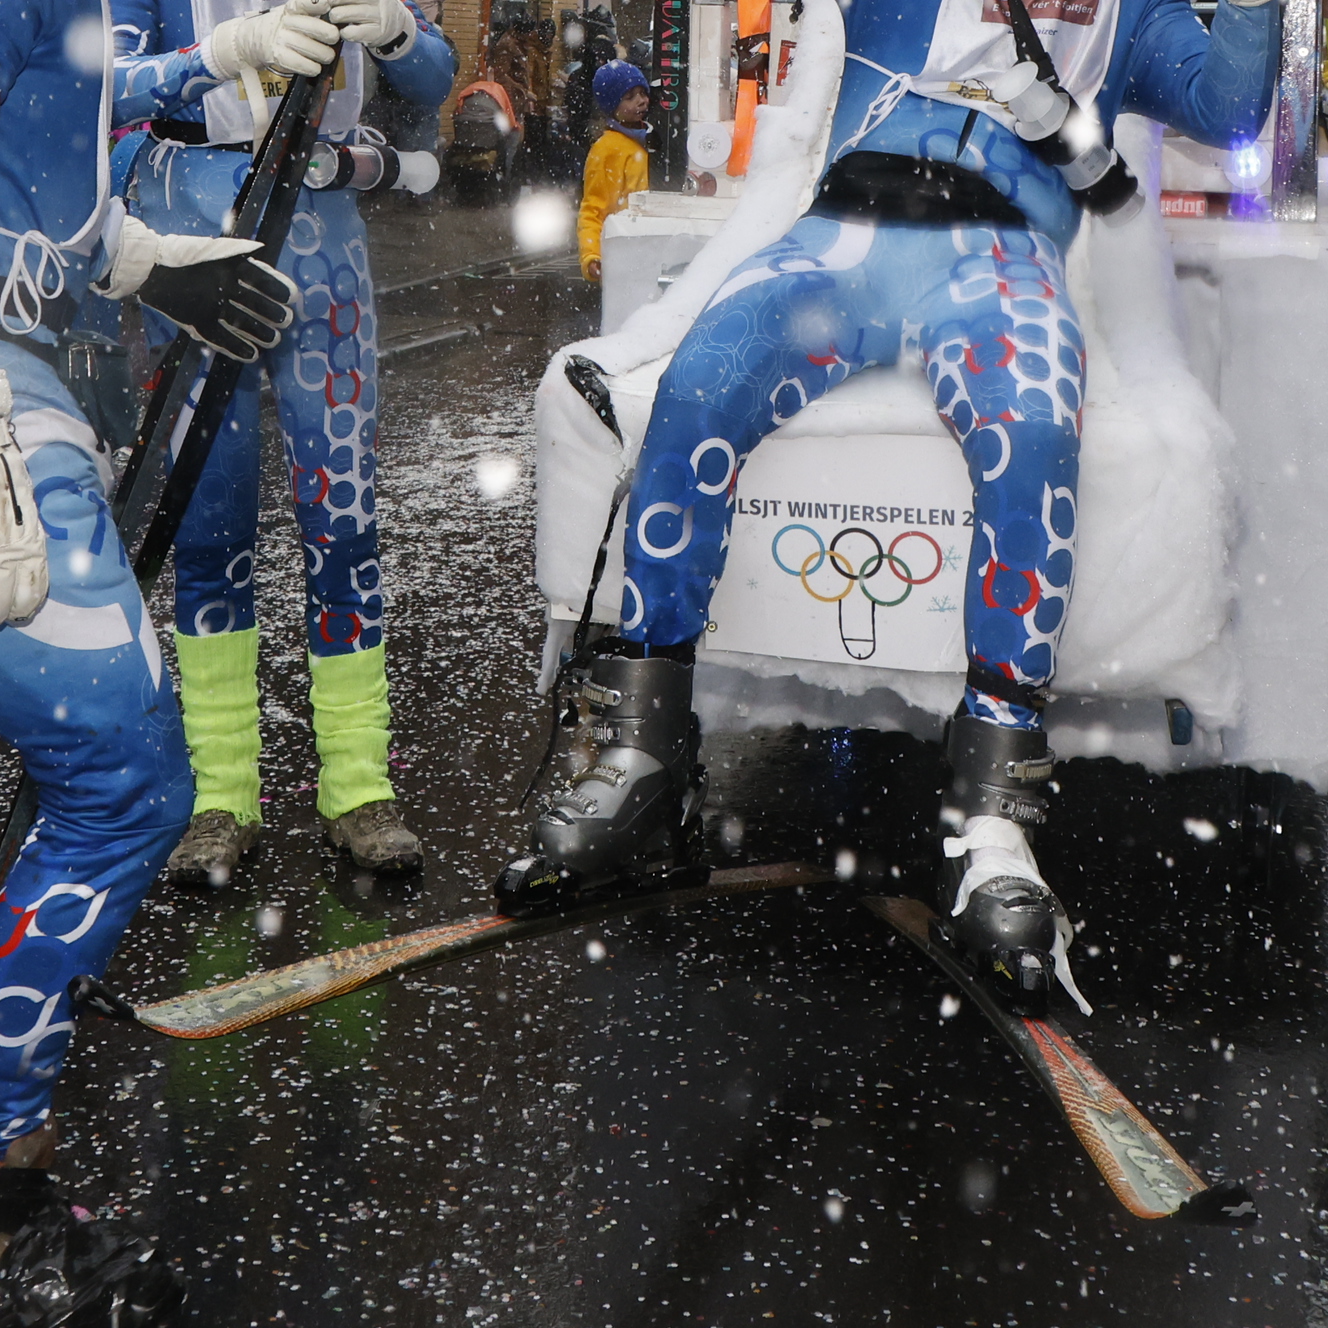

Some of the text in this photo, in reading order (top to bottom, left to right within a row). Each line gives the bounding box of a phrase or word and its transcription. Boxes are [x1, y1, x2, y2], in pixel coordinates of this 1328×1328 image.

[992, 3, 1000, 12] E
[1032, 0, 1049, 9] vér
[1062, 1, 1094, 15] foitjen
[1160, 197, 1206, 218] Jupil
[734, 497, 782, 519] LSJT
[787, 500, 956, 527] WINTJERSPELEN
